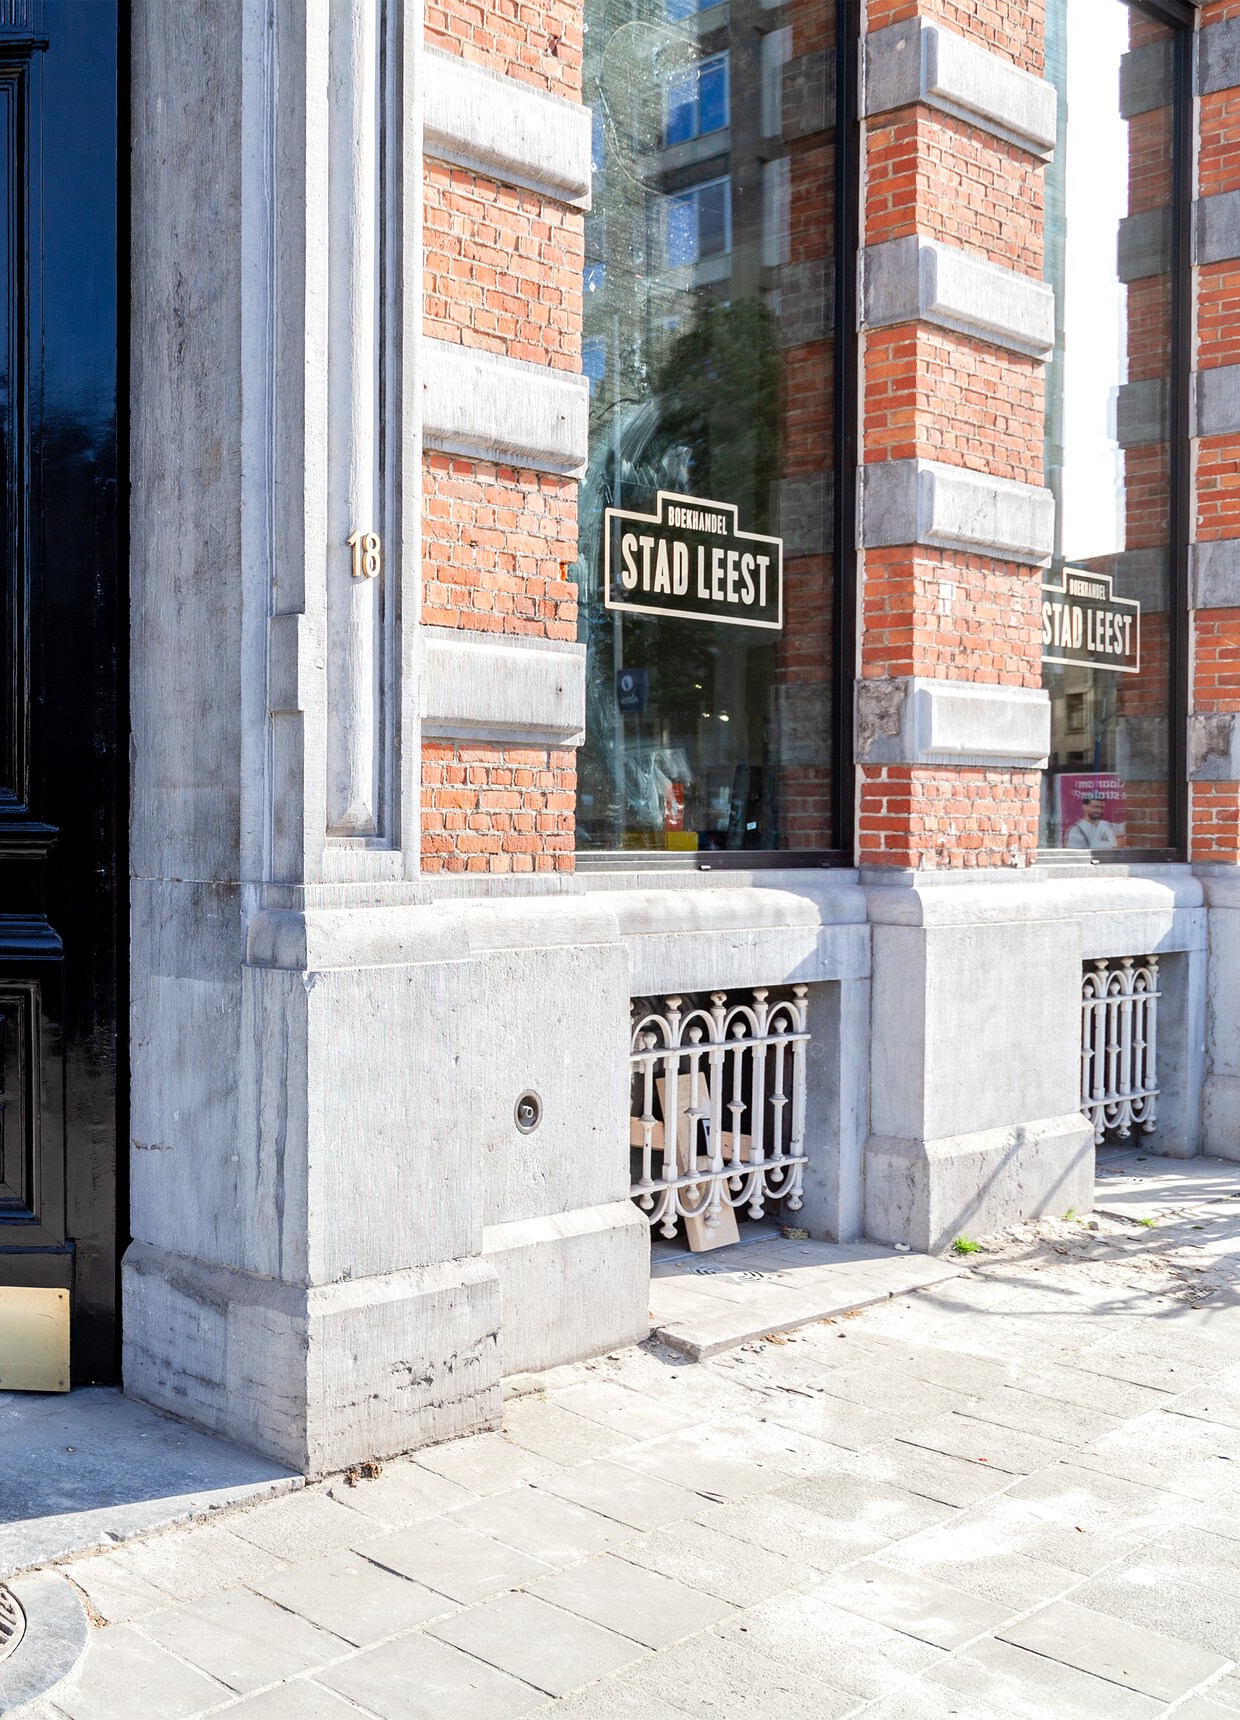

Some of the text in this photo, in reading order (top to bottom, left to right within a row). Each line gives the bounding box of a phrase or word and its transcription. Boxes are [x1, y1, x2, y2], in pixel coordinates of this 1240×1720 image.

[668, 505, 728, 535] BOEKHANDEL
[346, 530, 380, 578] 18
[621, 533, 770, 607] STAD LEEST
[1069, 579, 1106, 600] BOEKHANDEL
[1042, 601, 1132, 656] STAD LEEST
